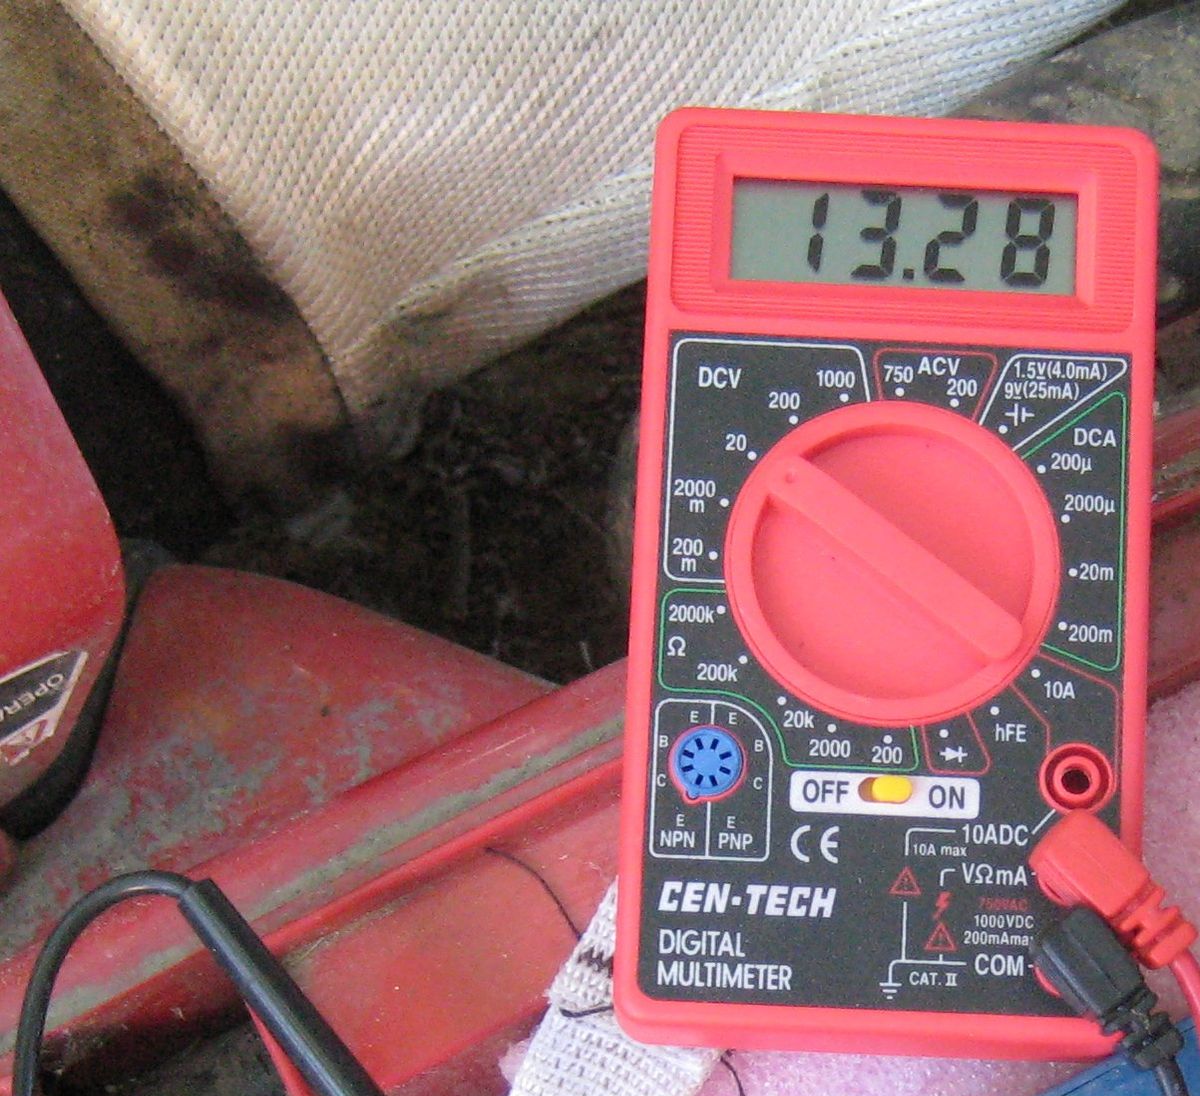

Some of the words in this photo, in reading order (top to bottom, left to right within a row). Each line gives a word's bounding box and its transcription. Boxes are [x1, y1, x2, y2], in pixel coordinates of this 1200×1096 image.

[807, 188, 1057, 287] 13.28
[883, 364, 914, 384] 750
[917, 356, 961, 377] ACV
[698, 366, 742, 390] DCV
[815, 369, 856, 388] 1000
[946, 378, 978, 398] 200
[768, 391, 800, 410] 200
[725, 433, 747, 452] 20
[1073, 427, 1117, 447] DCA
[673, 479, 717, 498] 2000
[689, 499, 705, 513] m
[672, 537, 704, 556] 200
[680, 557, 697, 572] m
[1079, 562, 1114, 581] 20m
[668, 604, 714, 624] 2000k
[1068, 624, 1113, 643] 200m
[696, 662, 738, 682] 200k
[1043, 680, 1076, 700] 10A
[689, 711, 700, 724] E
[728, 712, 738, 725] E
[783, 709, 815, 729] 20k
[659, 734, 669, 748] B
[995, 722, 1026, 743] hFE
[754, 739, 765, 752] B
[809, 738, 851, 758] 2000
[871, 746, 903, 765] 200
[656, 773, 667, 787] C
[752, 776, 763, 790] C
[802, 778, 850, 803] OFF
[928, 785, 966, 810] ON
[675, 813, 686, 827] E
[726, 816, 737, 829] E
[659, 829, 696, 848] NPN
[718, 832, 754, 850] PNP
[790, 824, 840, 864] CE
[961, 823, 1029, 847] 10ADC
[913, 843, 937, 857] 10A
[940, 845, 968, 858] max
[973, 914, 1035, 929] 1000VDC
[658, 928, 746, 957] DIGITAL
[963, 930, 1034, 946] 200mAma
[974, 953, 1025, 977] COM
[656, 960, 793, 991] MULTIMETER
[908, 971, 942, 987] CAT.
